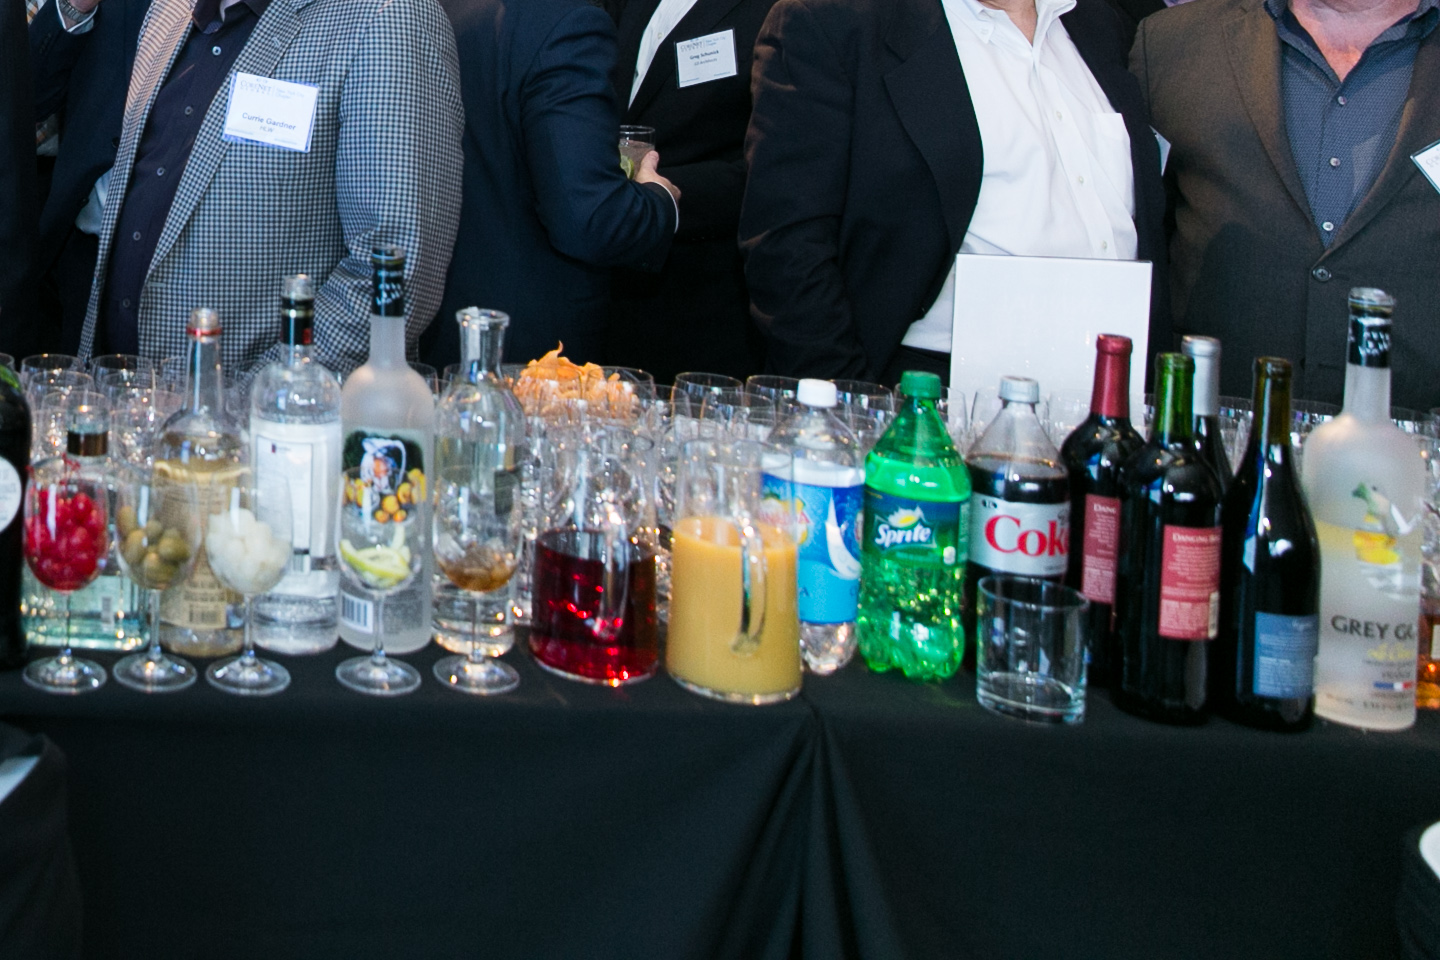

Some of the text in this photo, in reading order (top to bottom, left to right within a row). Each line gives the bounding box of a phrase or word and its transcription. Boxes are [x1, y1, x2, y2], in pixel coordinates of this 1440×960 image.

[242, 112, 264, 124] Currie
[266, 118, 297, 131] Gardner
[875, 523, 932, 548] Sprite
[1331, 615, 1389, 639] GREY
